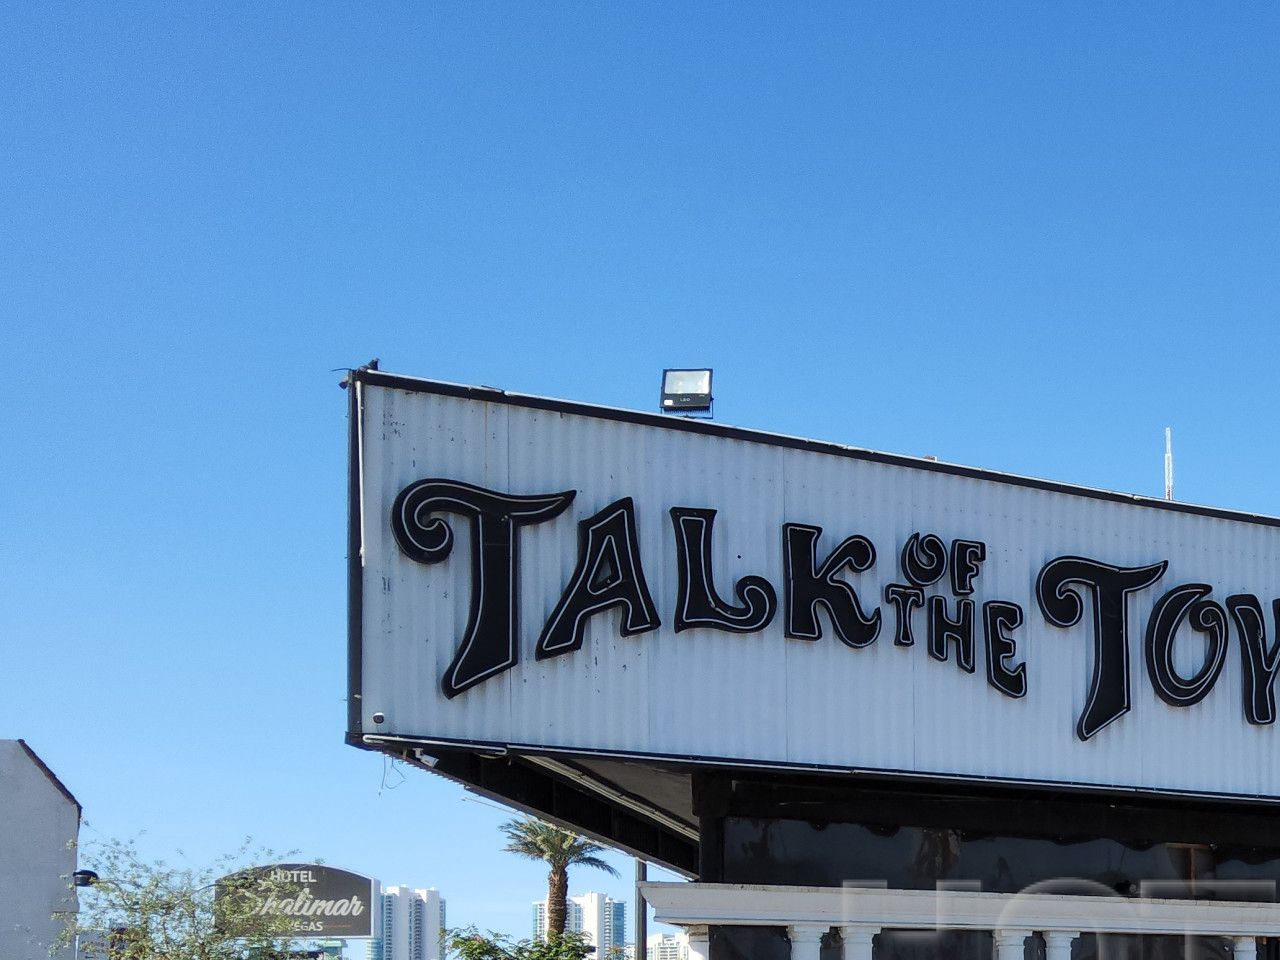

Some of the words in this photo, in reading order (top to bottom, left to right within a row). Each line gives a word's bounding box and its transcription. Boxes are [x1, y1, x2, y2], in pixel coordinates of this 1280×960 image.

[391, 478, 881, 699] TALK
[901, 532, 986, 597] OF
[885, 584, 1027, 699] THE
[271, 870, 317, 883] HOTEL
